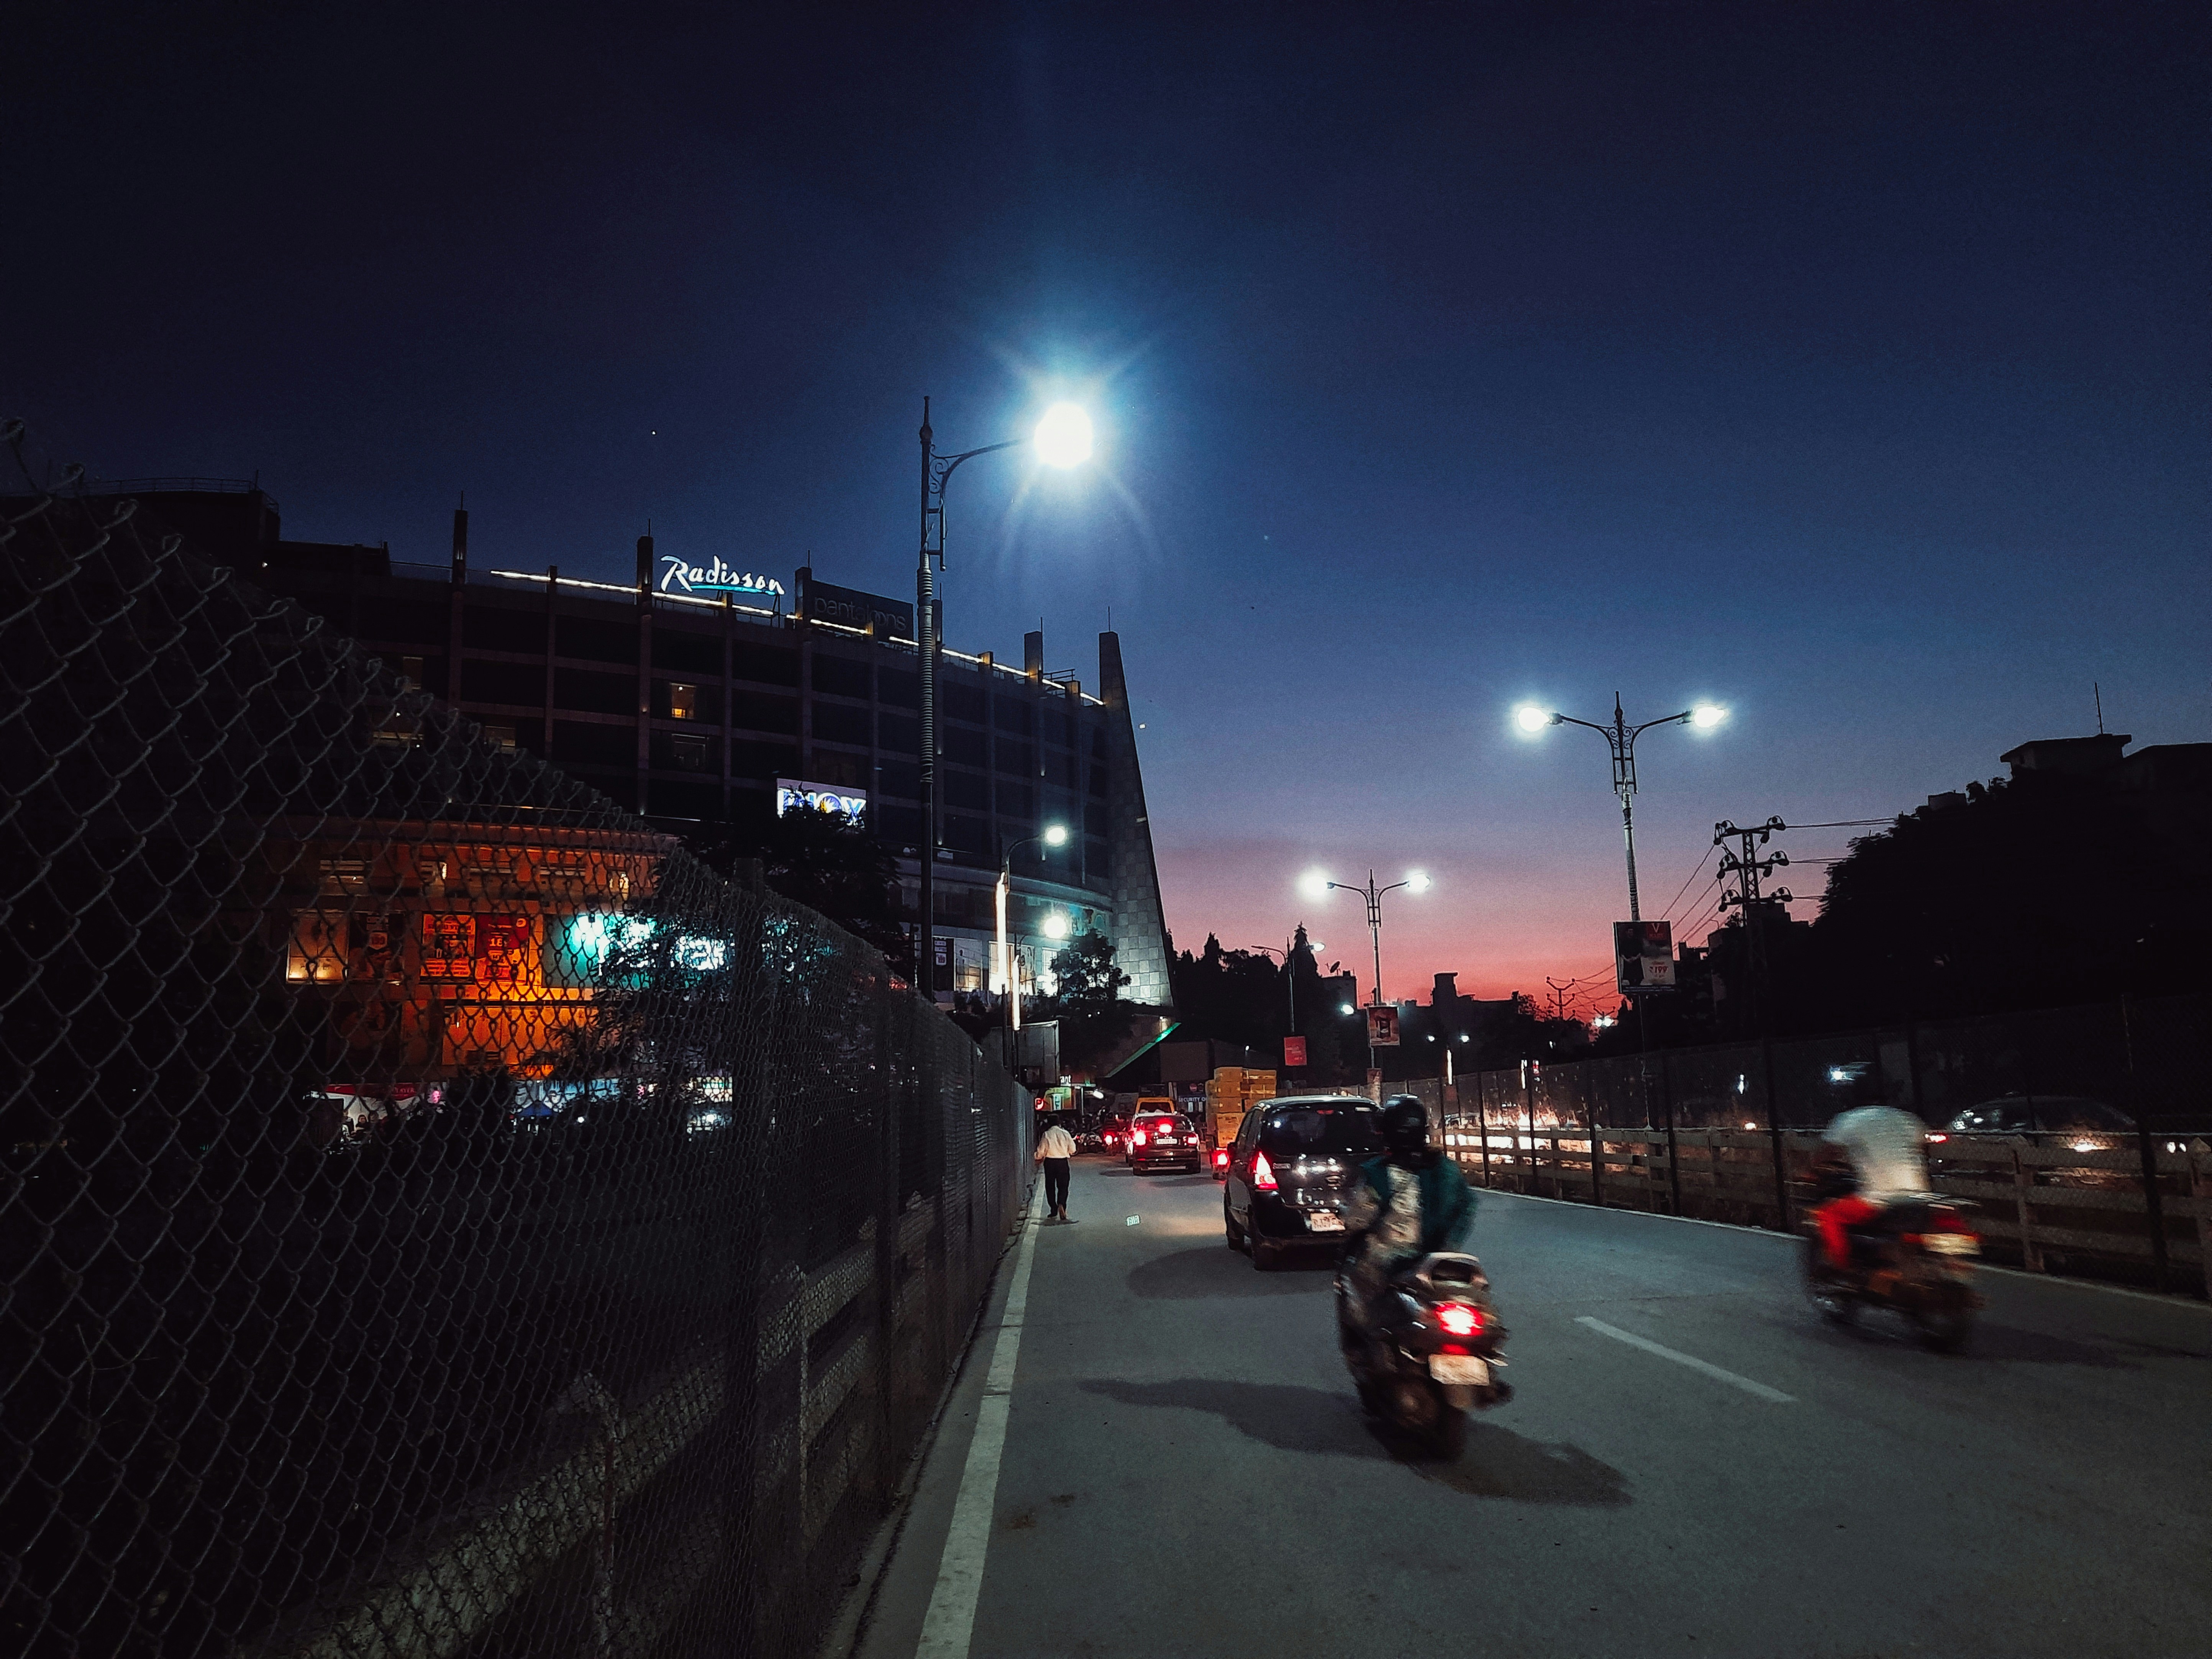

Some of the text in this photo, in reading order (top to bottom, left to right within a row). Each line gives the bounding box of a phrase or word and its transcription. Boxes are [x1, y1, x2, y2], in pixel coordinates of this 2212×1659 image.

[660, 555, 785, 595] Radisson
[814, 596, 907, 631] pantaloons
[1651, 923, 1660, 933] V
